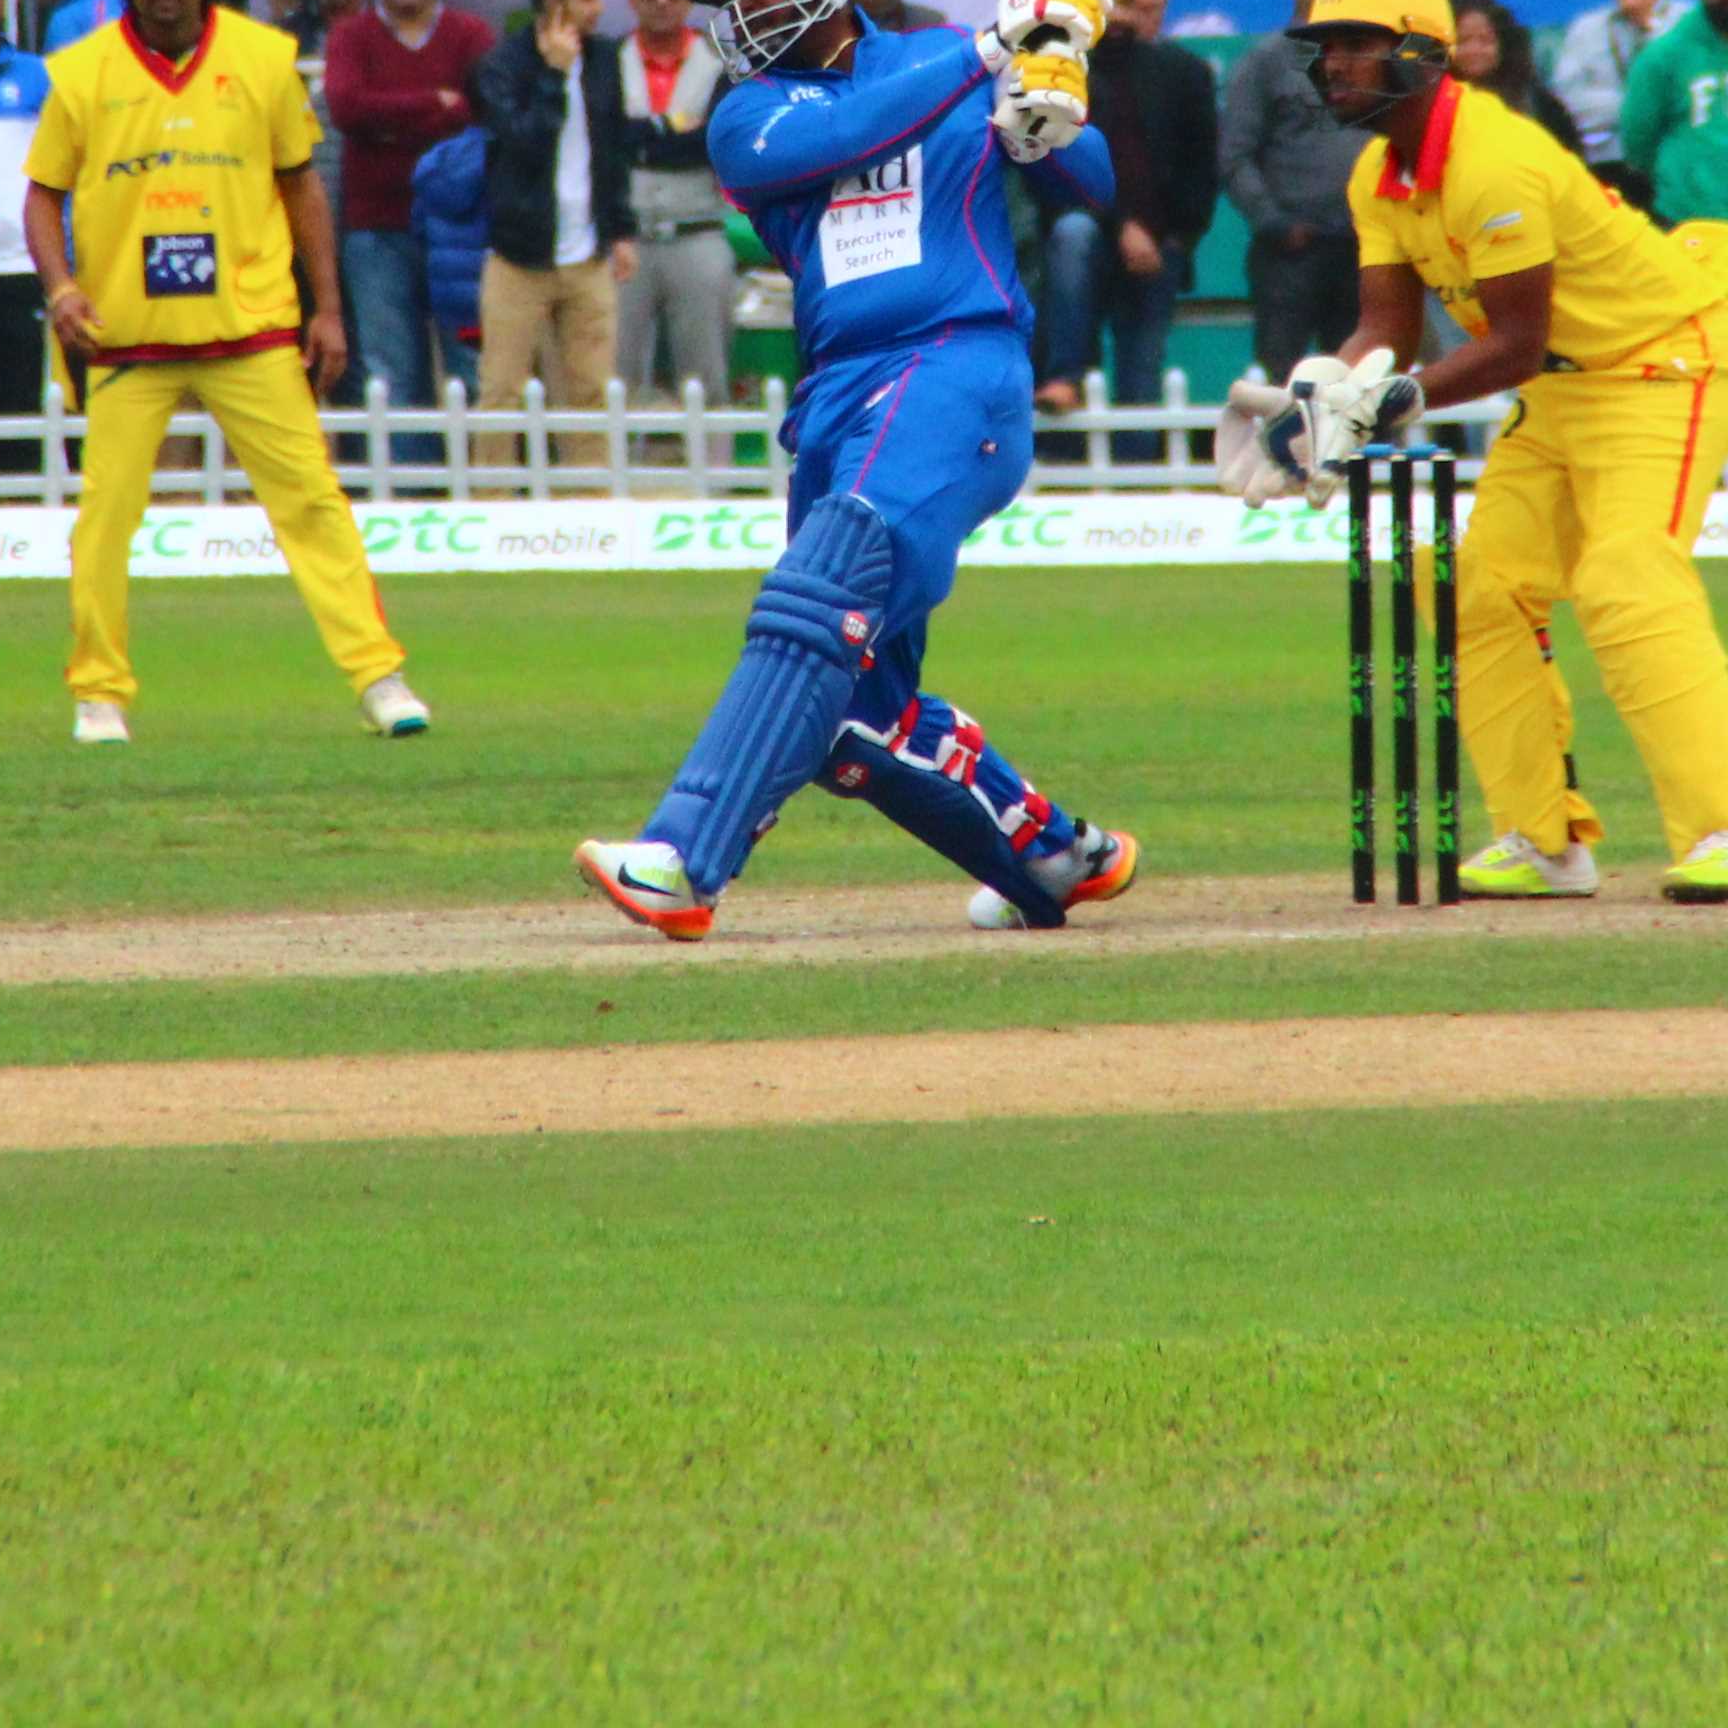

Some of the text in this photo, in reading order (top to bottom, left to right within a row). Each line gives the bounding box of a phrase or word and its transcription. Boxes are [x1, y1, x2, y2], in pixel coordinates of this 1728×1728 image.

[835, 226, 907, 253] Executive
[845, 247, 895, 271] Search
[203, 531, 279, 559] mob
[496, 524, 618, 555] mobile
[1084, 520, 1205, 548] mobile
